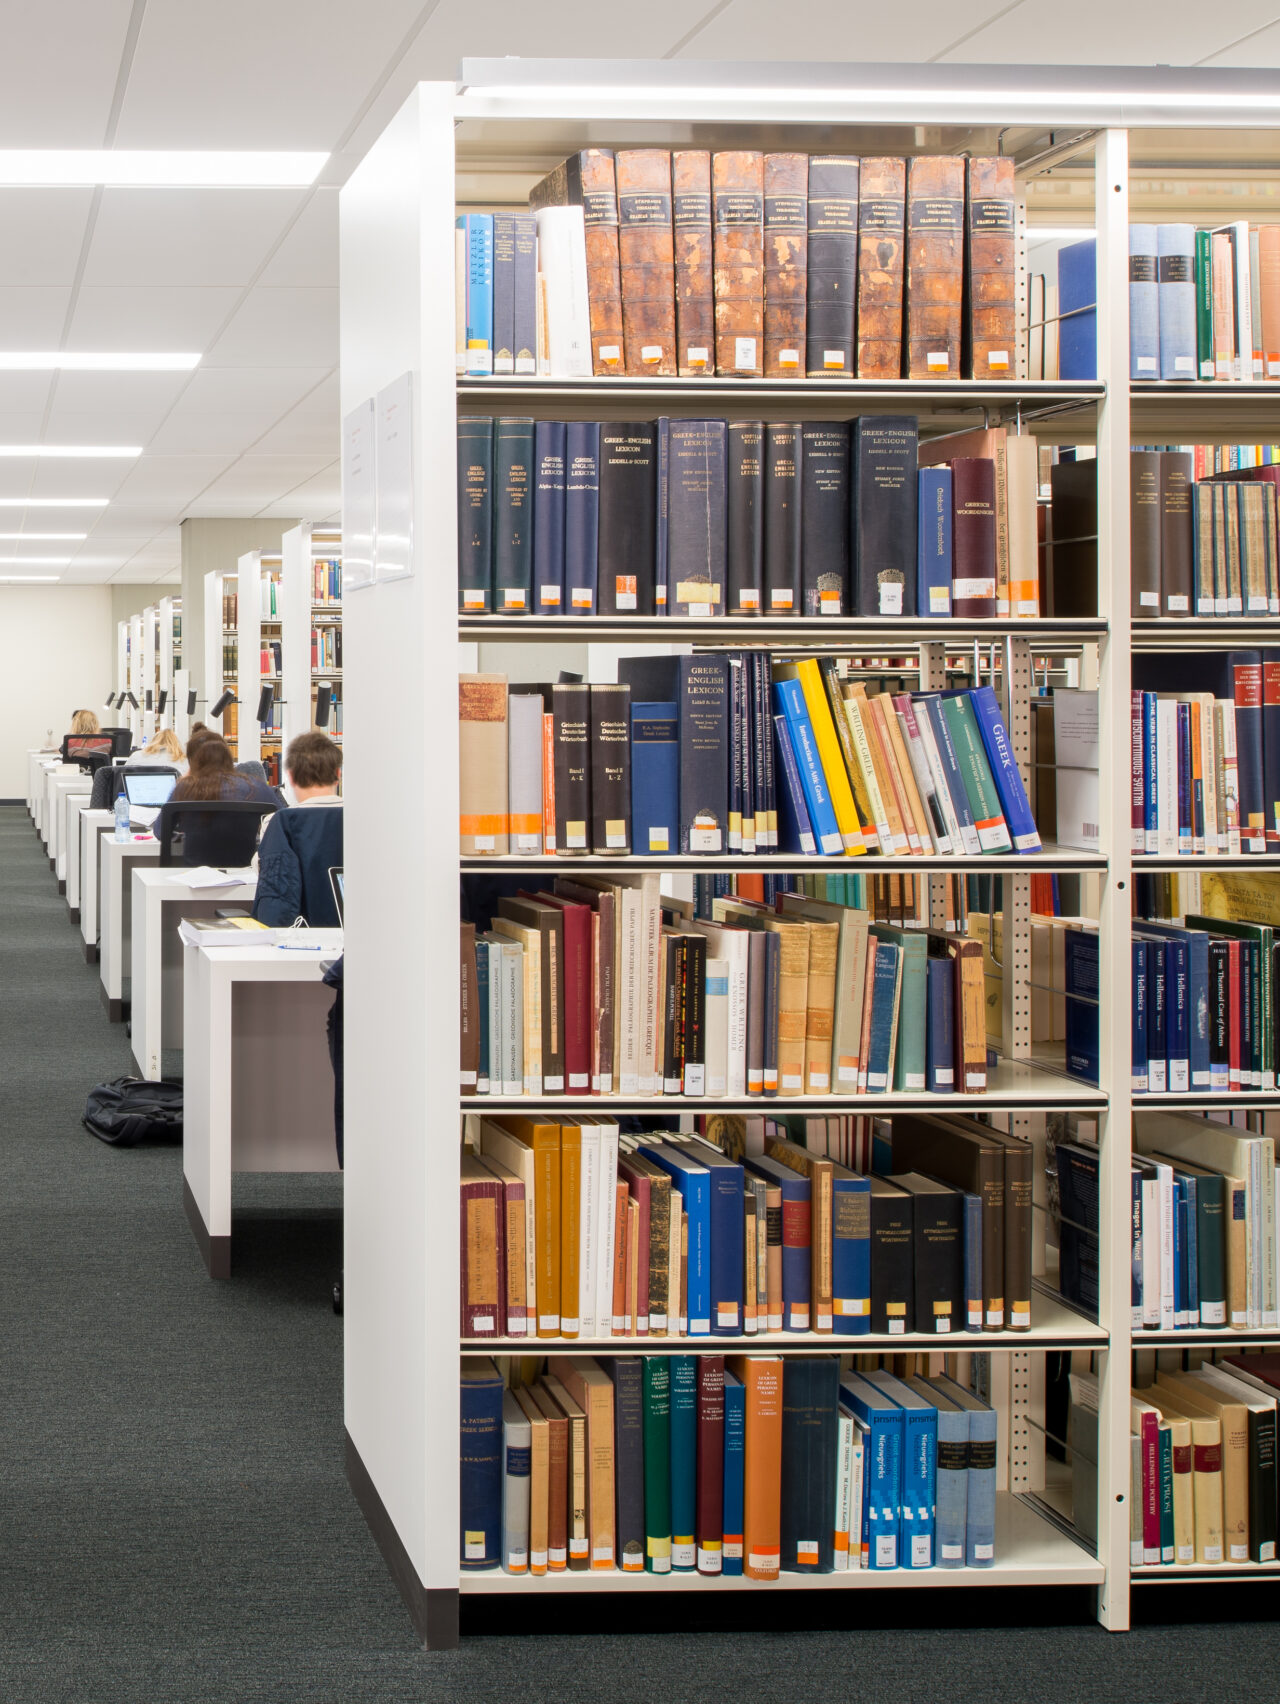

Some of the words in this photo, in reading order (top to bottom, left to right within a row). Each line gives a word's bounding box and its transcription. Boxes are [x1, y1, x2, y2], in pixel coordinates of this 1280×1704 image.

[852, 706, 867, 746] WRITING
[862, 747, 874, 777] GREEK
[992, 723, 1013, 768] GREEK
[1133, 719, 1143, 775] DISCONTINUOUS
[800, 725, 814, 761] Introduction
[811, 770, 819, 784] Attic
[815, 785, 825, 804] Greek
[1133, 778, 1143, 806] SYNTAX
[874, 1416, 902, 1425] prisma
[909, 1416, 936, 1425] prisma
[878, 1434, 886, 1479] Nieuwgrieks
